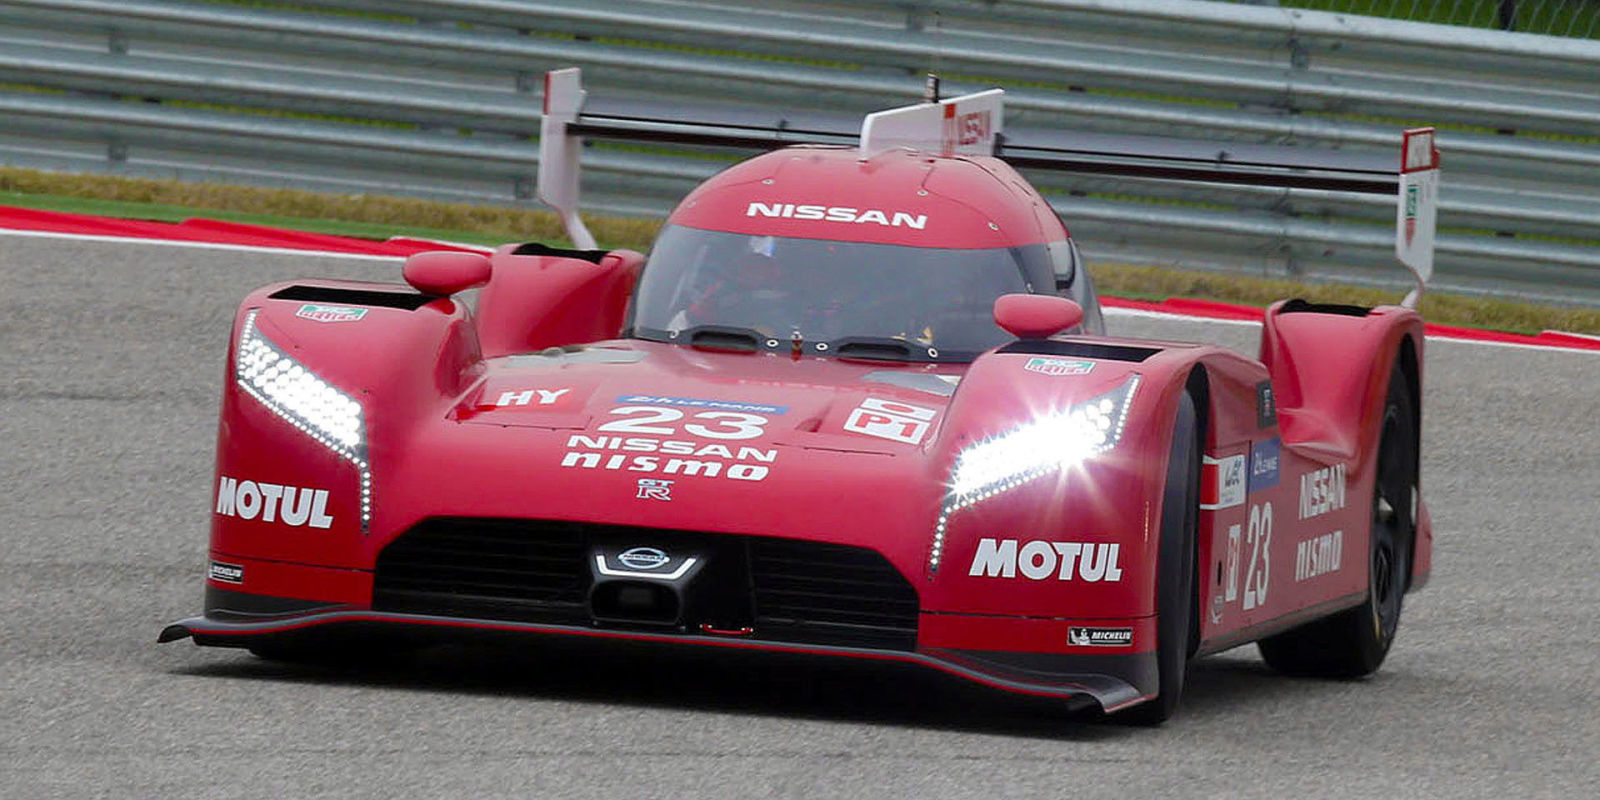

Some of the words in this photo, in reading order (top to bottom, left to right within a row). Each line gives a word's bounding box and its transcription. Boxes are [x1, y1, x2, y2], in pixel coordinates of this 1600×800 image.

[747, 202, 928, 230] NISSAN
[496, 388, 570, 406] HY
[597, 405, 769, 440] 23
[855, 412, 919, 438] P1
[566, 434, 778, 462] NISSAN
[561, 451, 769, 481] nismo
[216, 476, 334, 528] MOTUL
[1299, 462, 1345, 520] NISSAN
[968, 538, 1123, 582] MOTUL
[1243, 501, 1273, 611] 23
[1295, 530, 1342, 582] nismo
[1091, 631, 1131, 640] MICHELIN
